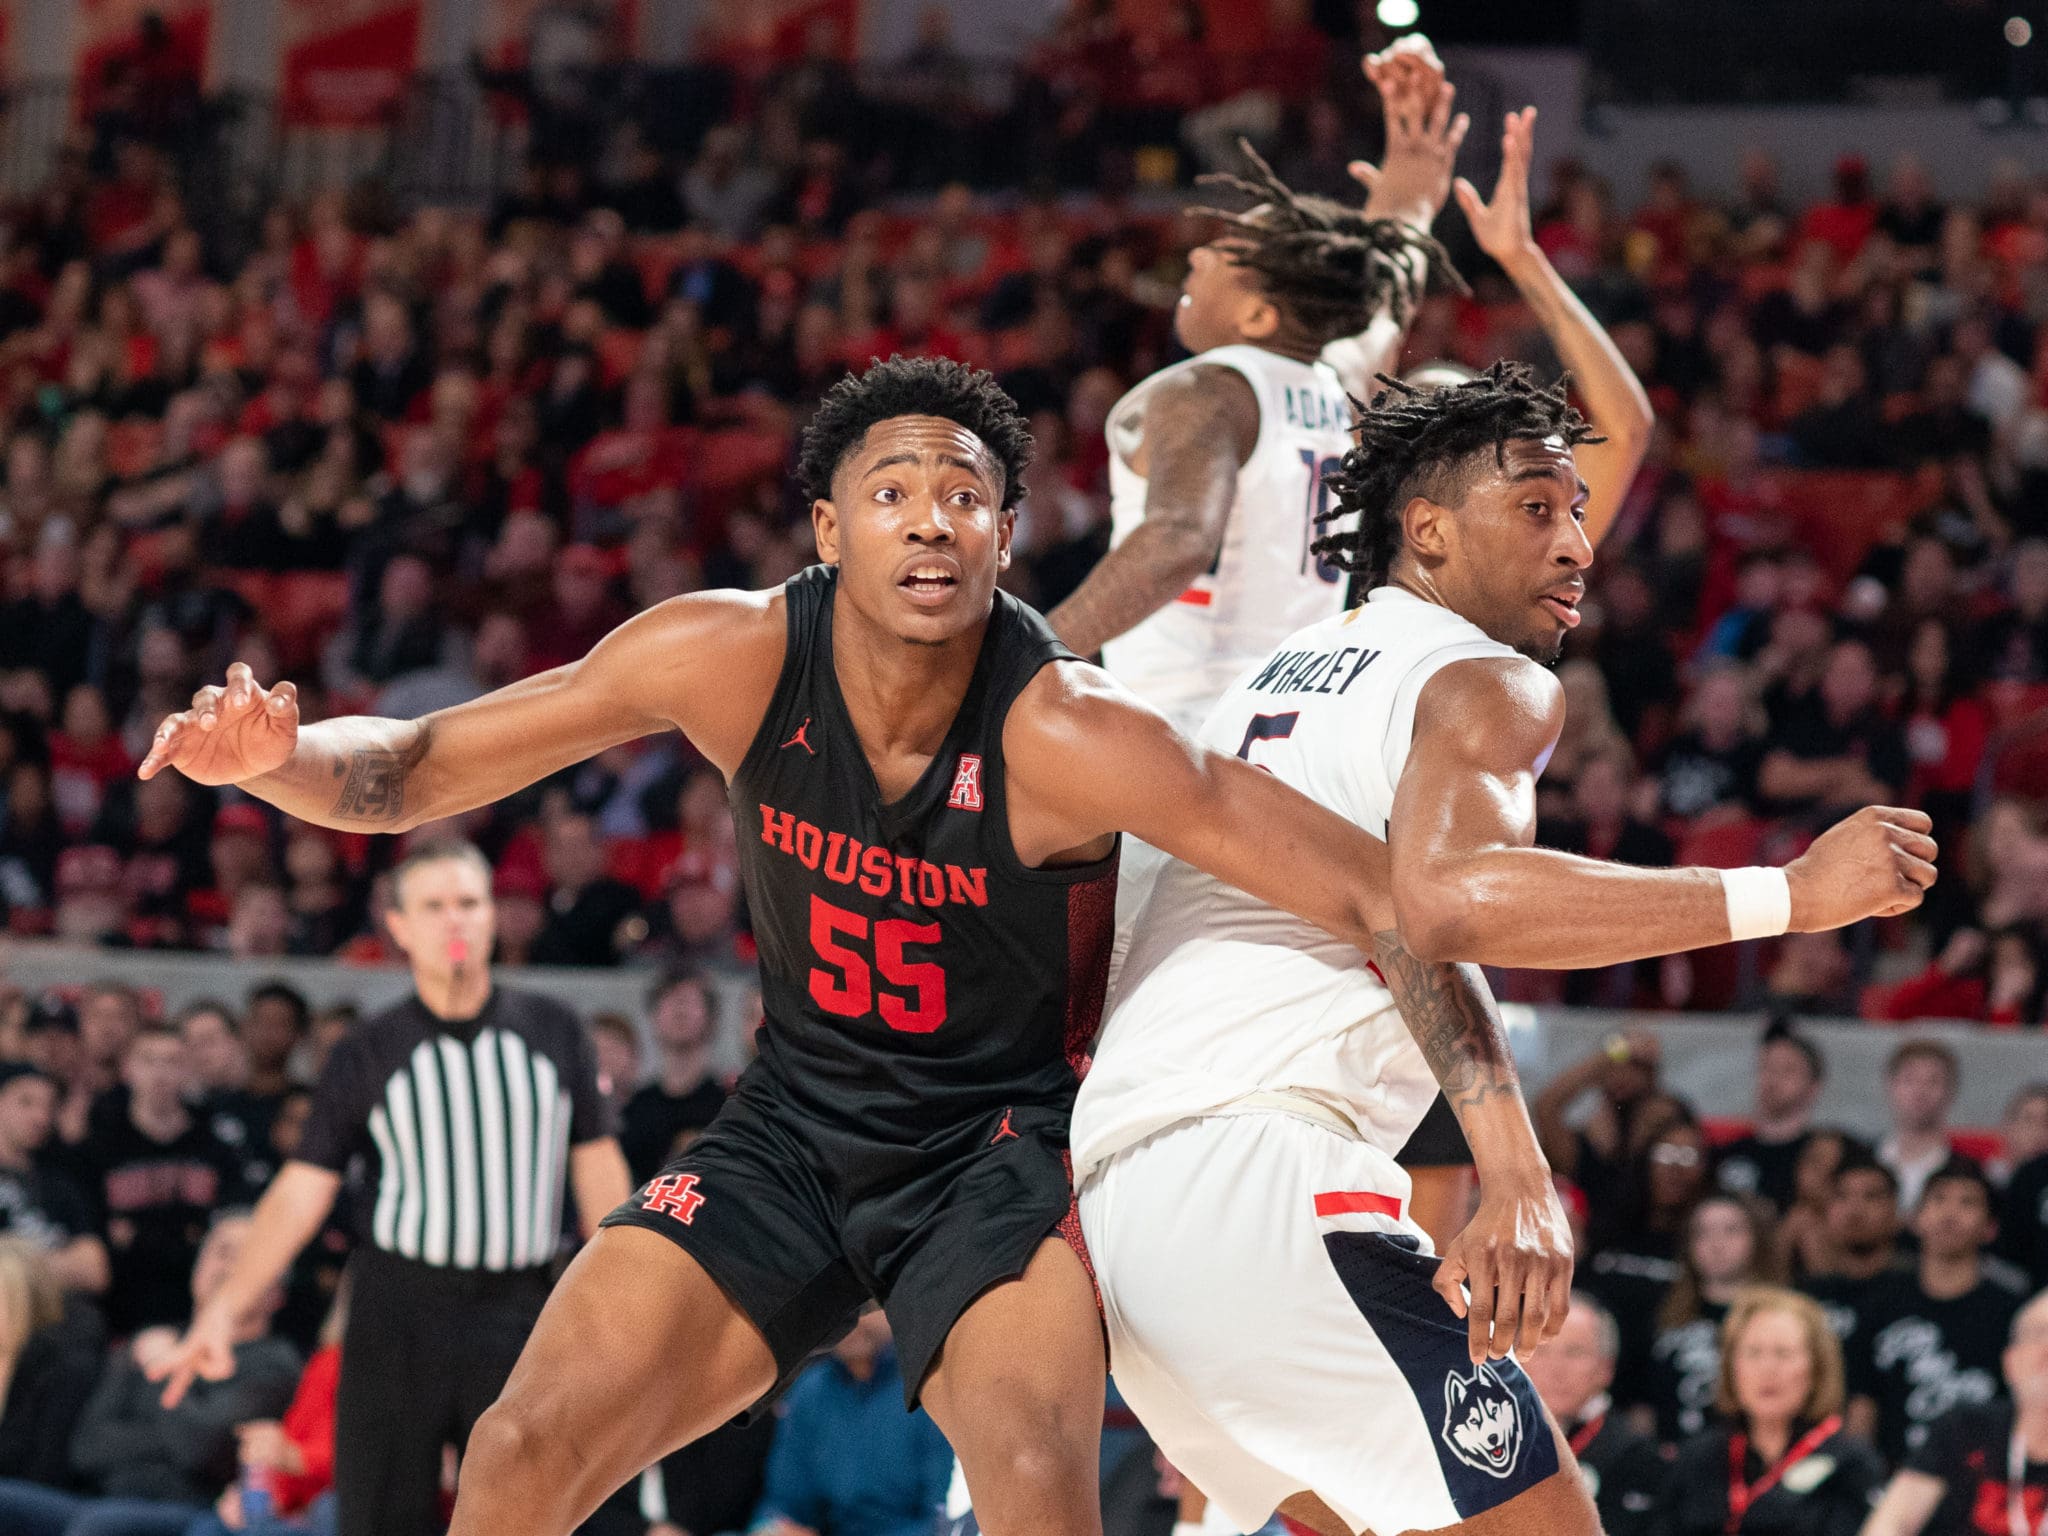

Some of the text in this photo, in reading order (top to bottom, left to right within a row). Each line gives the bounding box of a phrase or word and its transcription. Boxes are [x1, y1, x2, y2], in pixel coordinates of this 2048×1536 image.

[1247, 647, 1381, 695] WHALEY
[759, 803, 989, 908] HOUSTON
[808, 892, 948, 1034] 55
